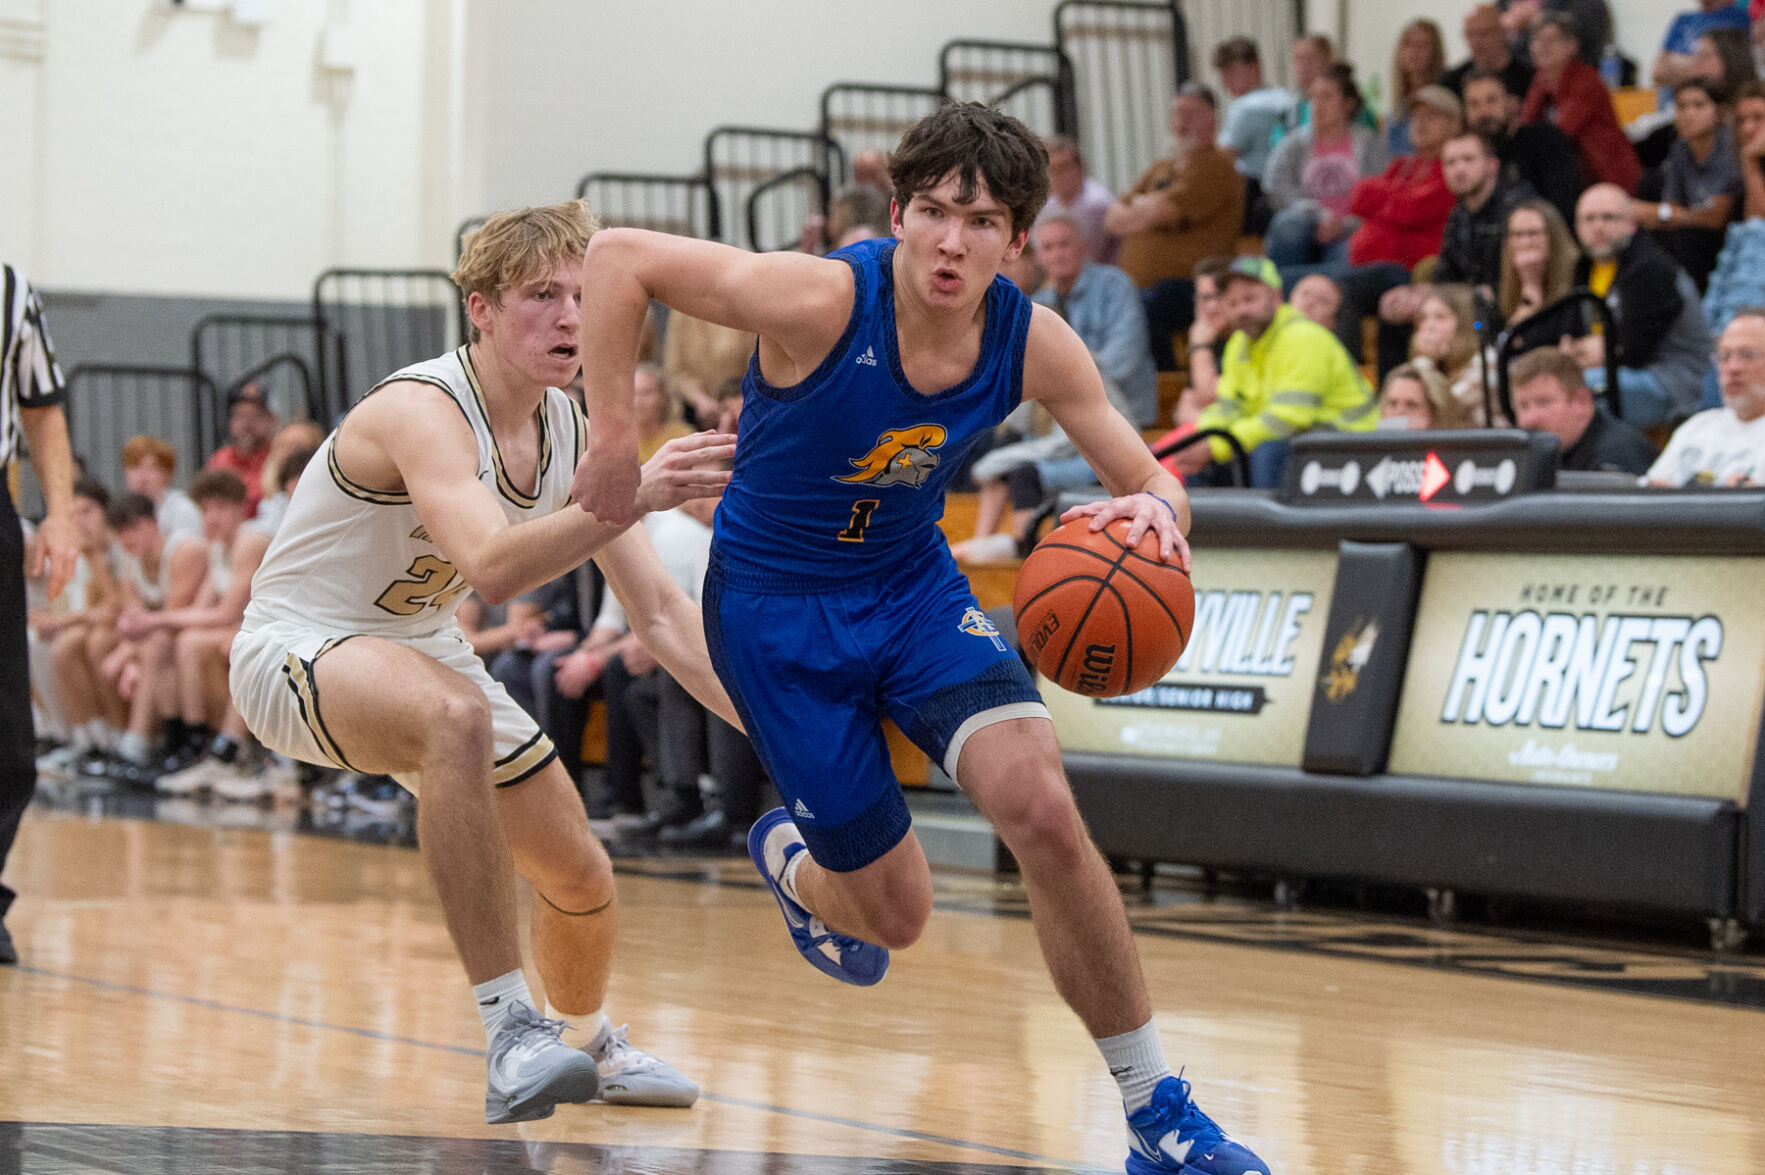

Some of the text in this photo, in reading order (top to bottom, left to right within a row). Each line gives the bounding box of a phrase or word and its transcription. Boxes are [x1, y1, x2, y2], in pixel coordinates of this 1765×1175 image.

[837, 499, 880, 542] 1
[373, 554, 466, 615] 2
[1519, 584, 1669, 607] HOME OF THE
[1026, 612, 1060, 661] EVOLU
[1441, 608, 1724, 738] HORNETS
